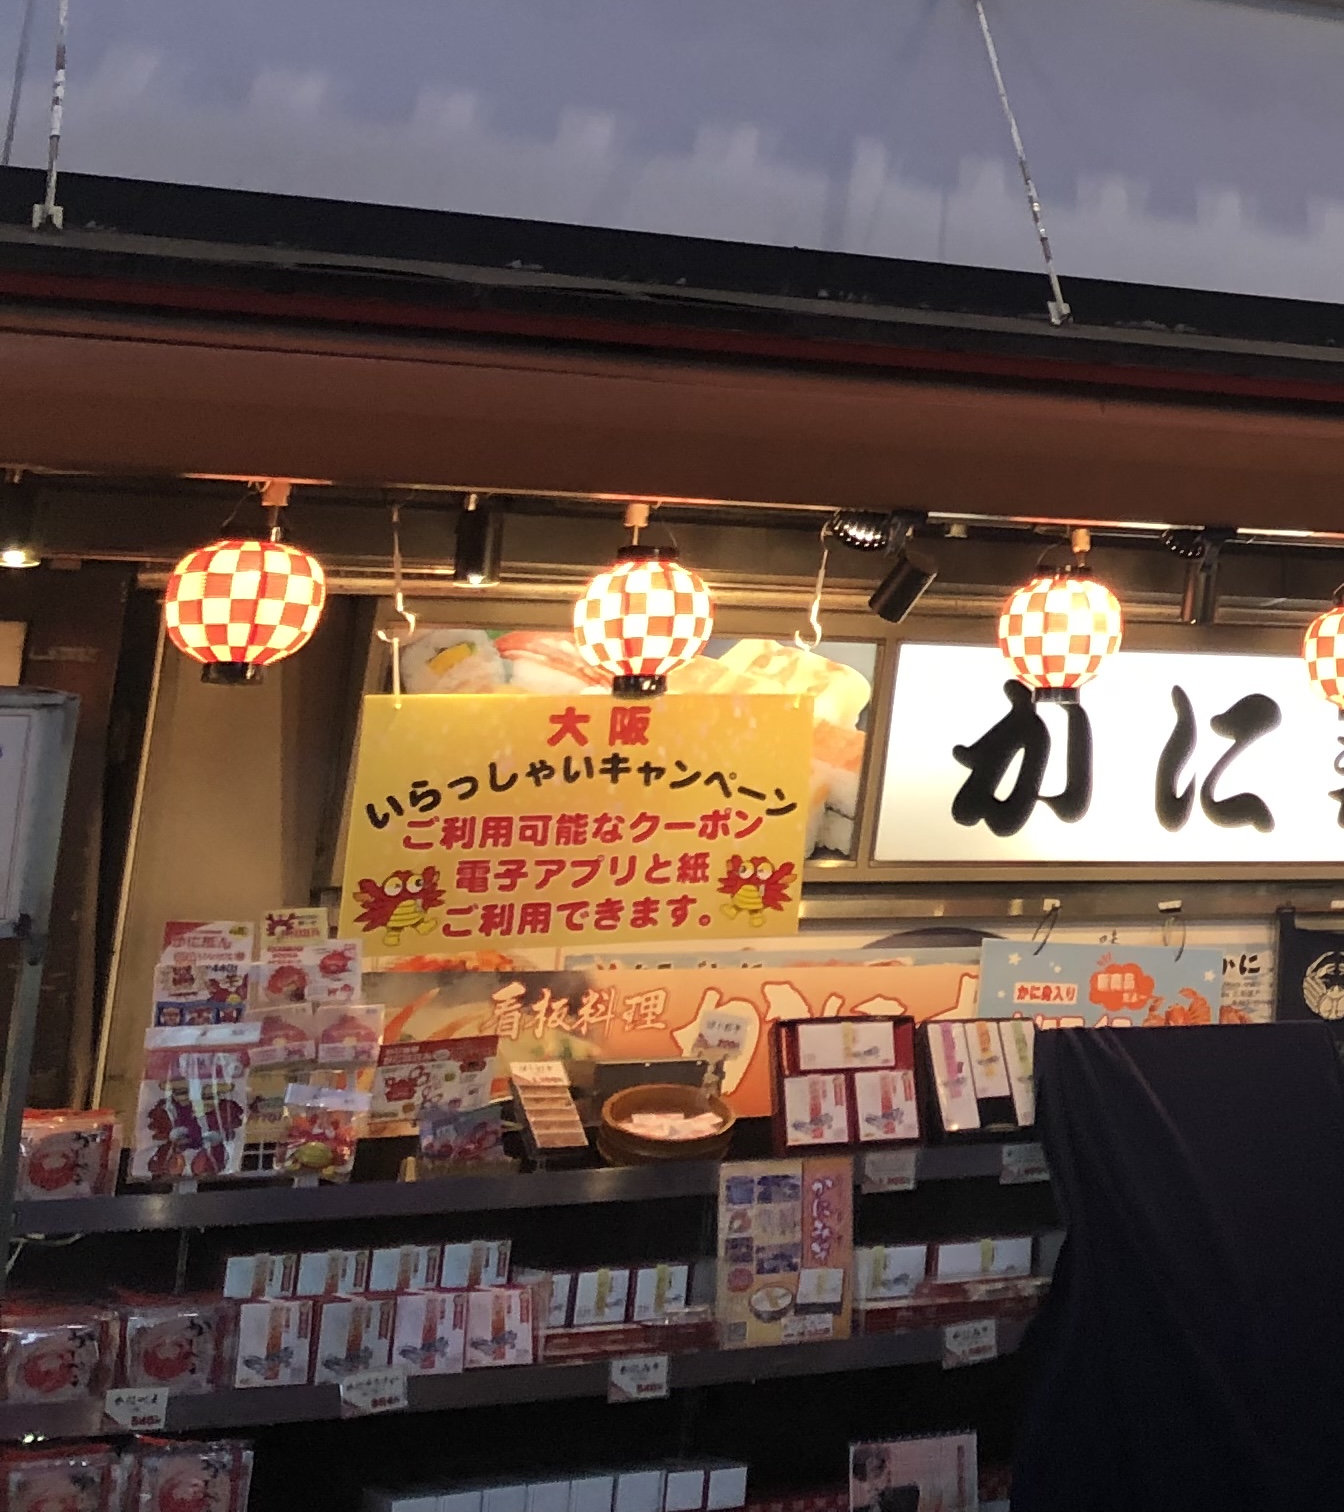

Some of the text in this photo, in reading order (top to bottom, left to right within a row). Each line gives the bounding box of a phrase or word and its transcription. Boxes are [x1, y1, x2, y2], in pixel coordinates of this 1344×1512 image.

[547, 706, 652, 747] 大阪
[366, 753, 798, 829] いらっしゃいキャンペーン
[402, 807, 764, 851] ご利用可能なクーポン
[455, 851, 711, 894] 電子アプリと紙
[441, 893, 712, 938] ご利用できます。
[480, 981, 669, 1040] 看板料理
